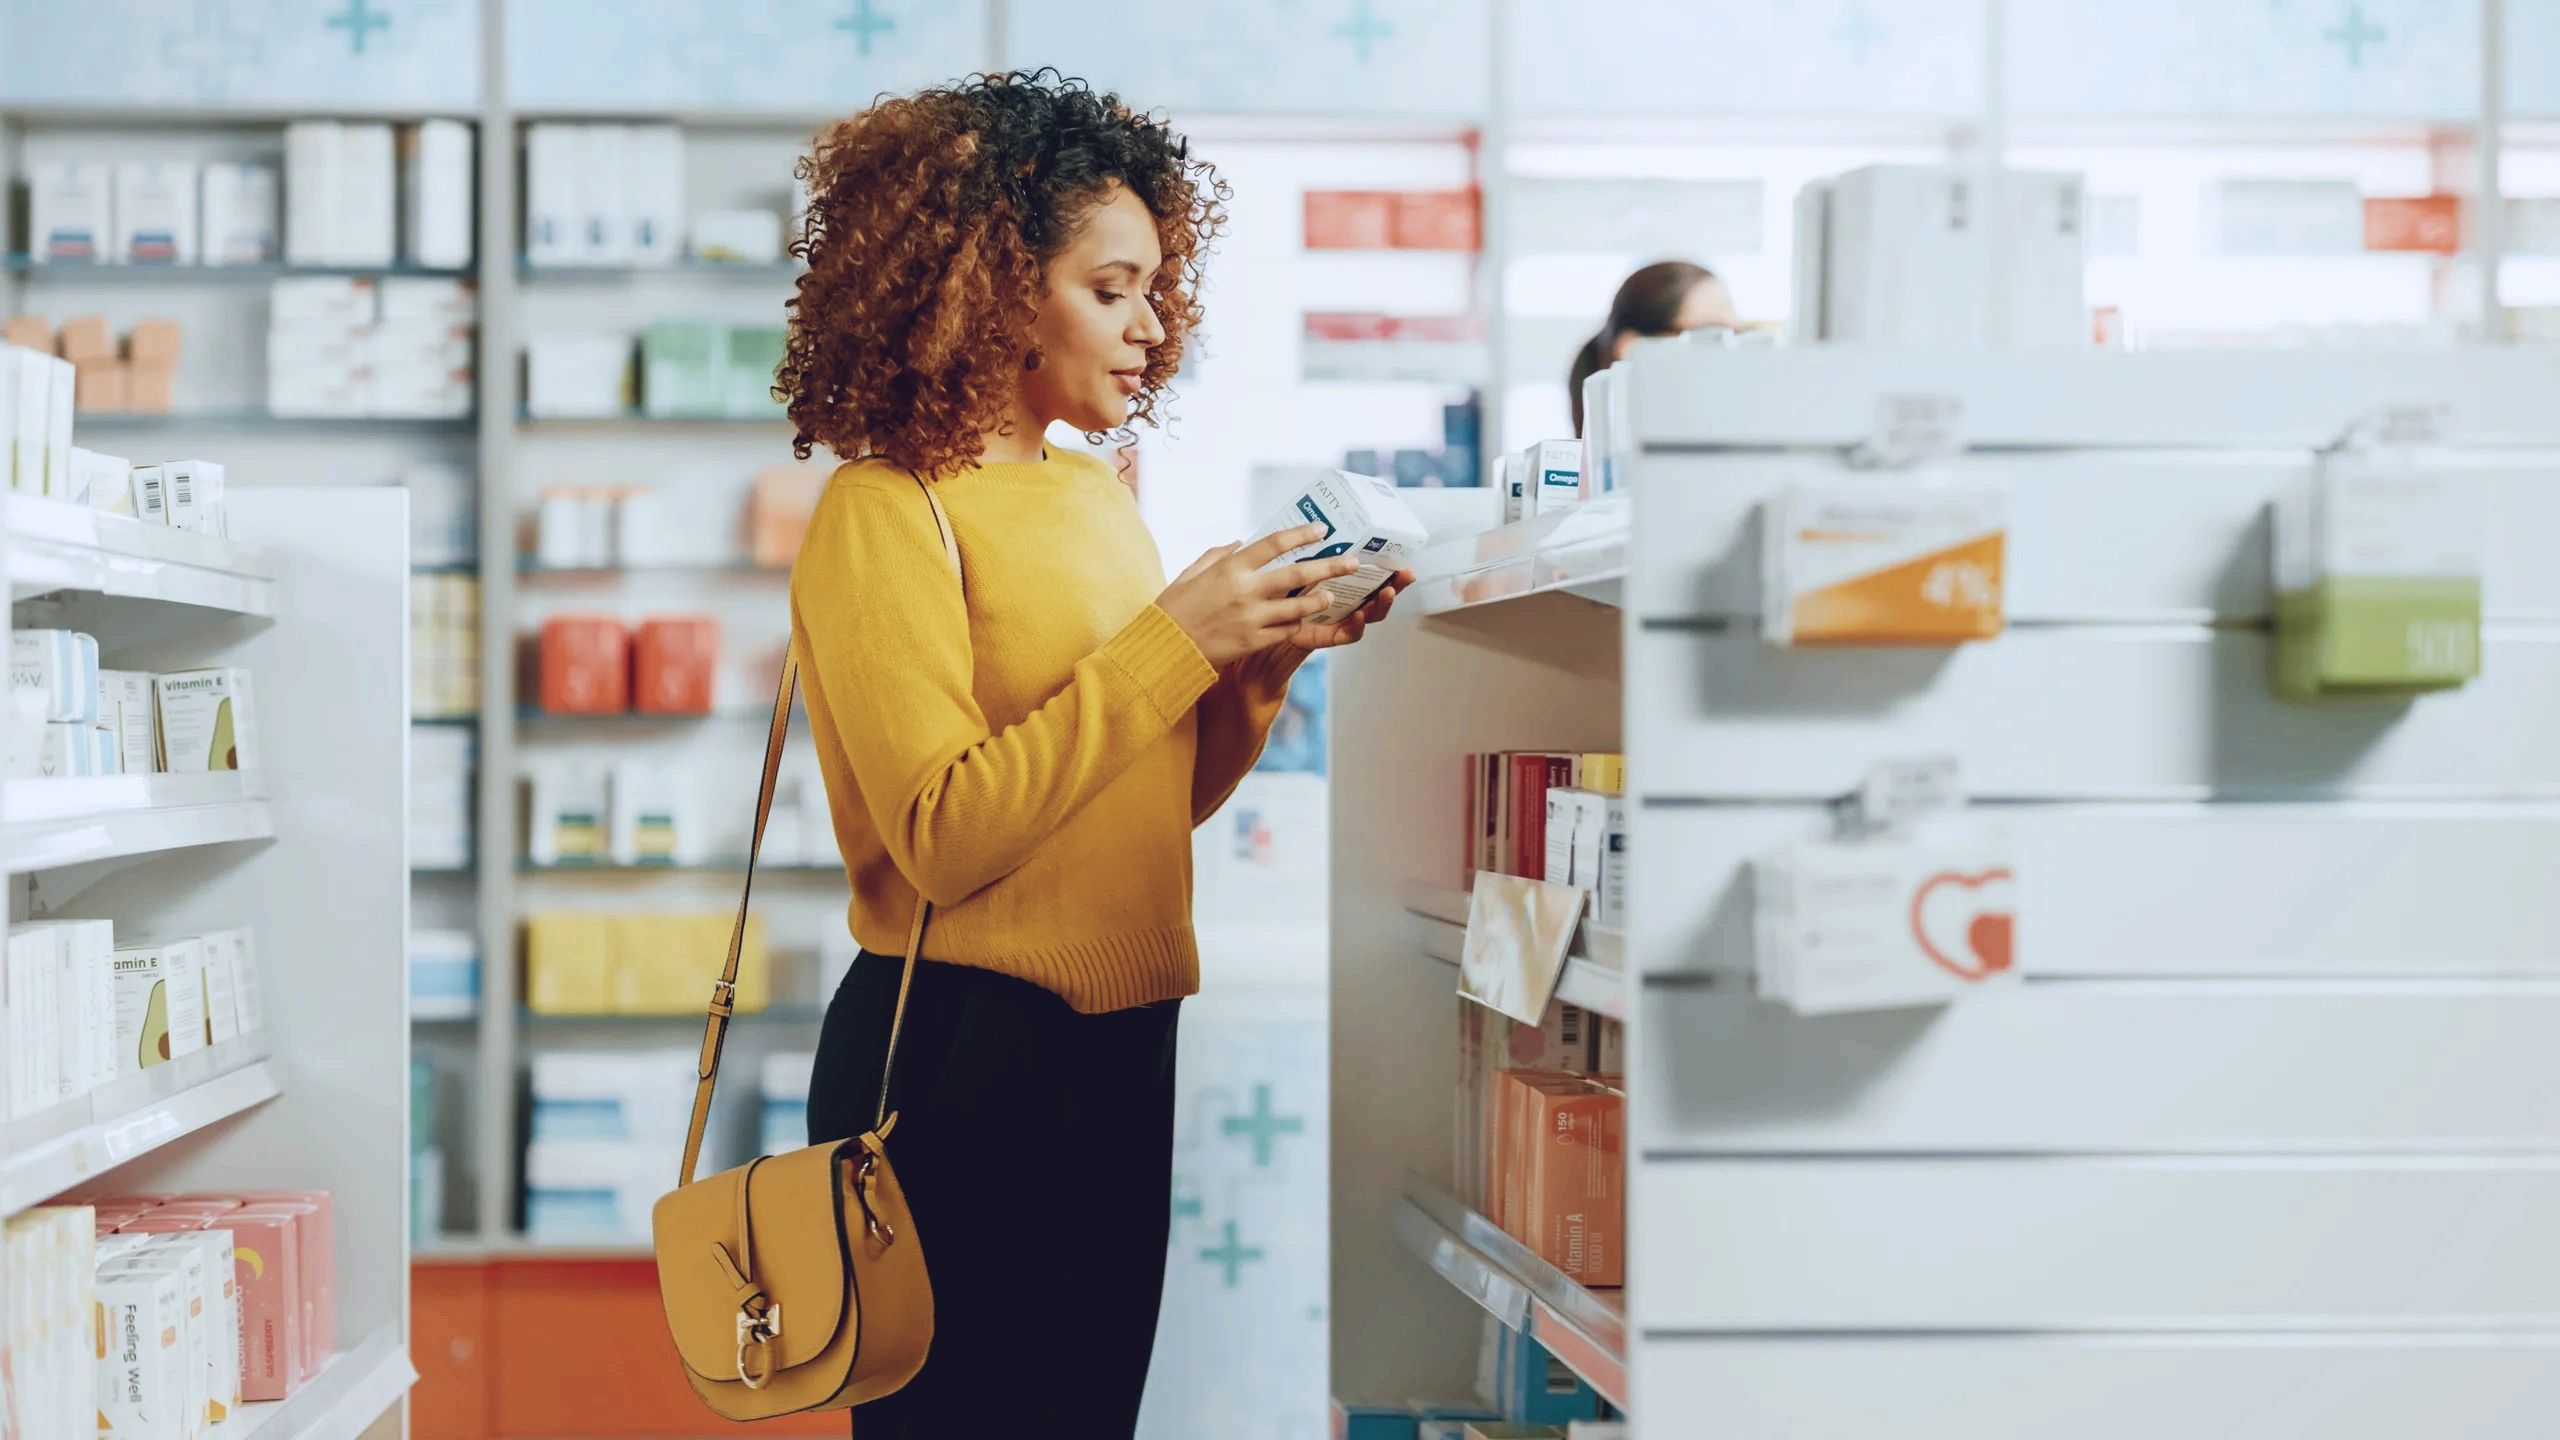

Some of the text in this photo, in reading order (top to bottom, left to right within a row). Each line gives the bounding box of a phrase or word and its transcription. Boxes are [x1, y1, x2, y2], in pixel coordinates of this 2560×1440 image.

[1549, 473, 1579, 485] Omega
[1315, 480, 1343, 510] FATTY
[164, 676, 224, 692] Vitamin E
[114, 957, 158, 970] amin E
[1557, 1111, 1568, 1132] 150
[1564, 1213, 1584, 1274] Vitamin A
[122, 1304, 143, 1403] Feeling Well
